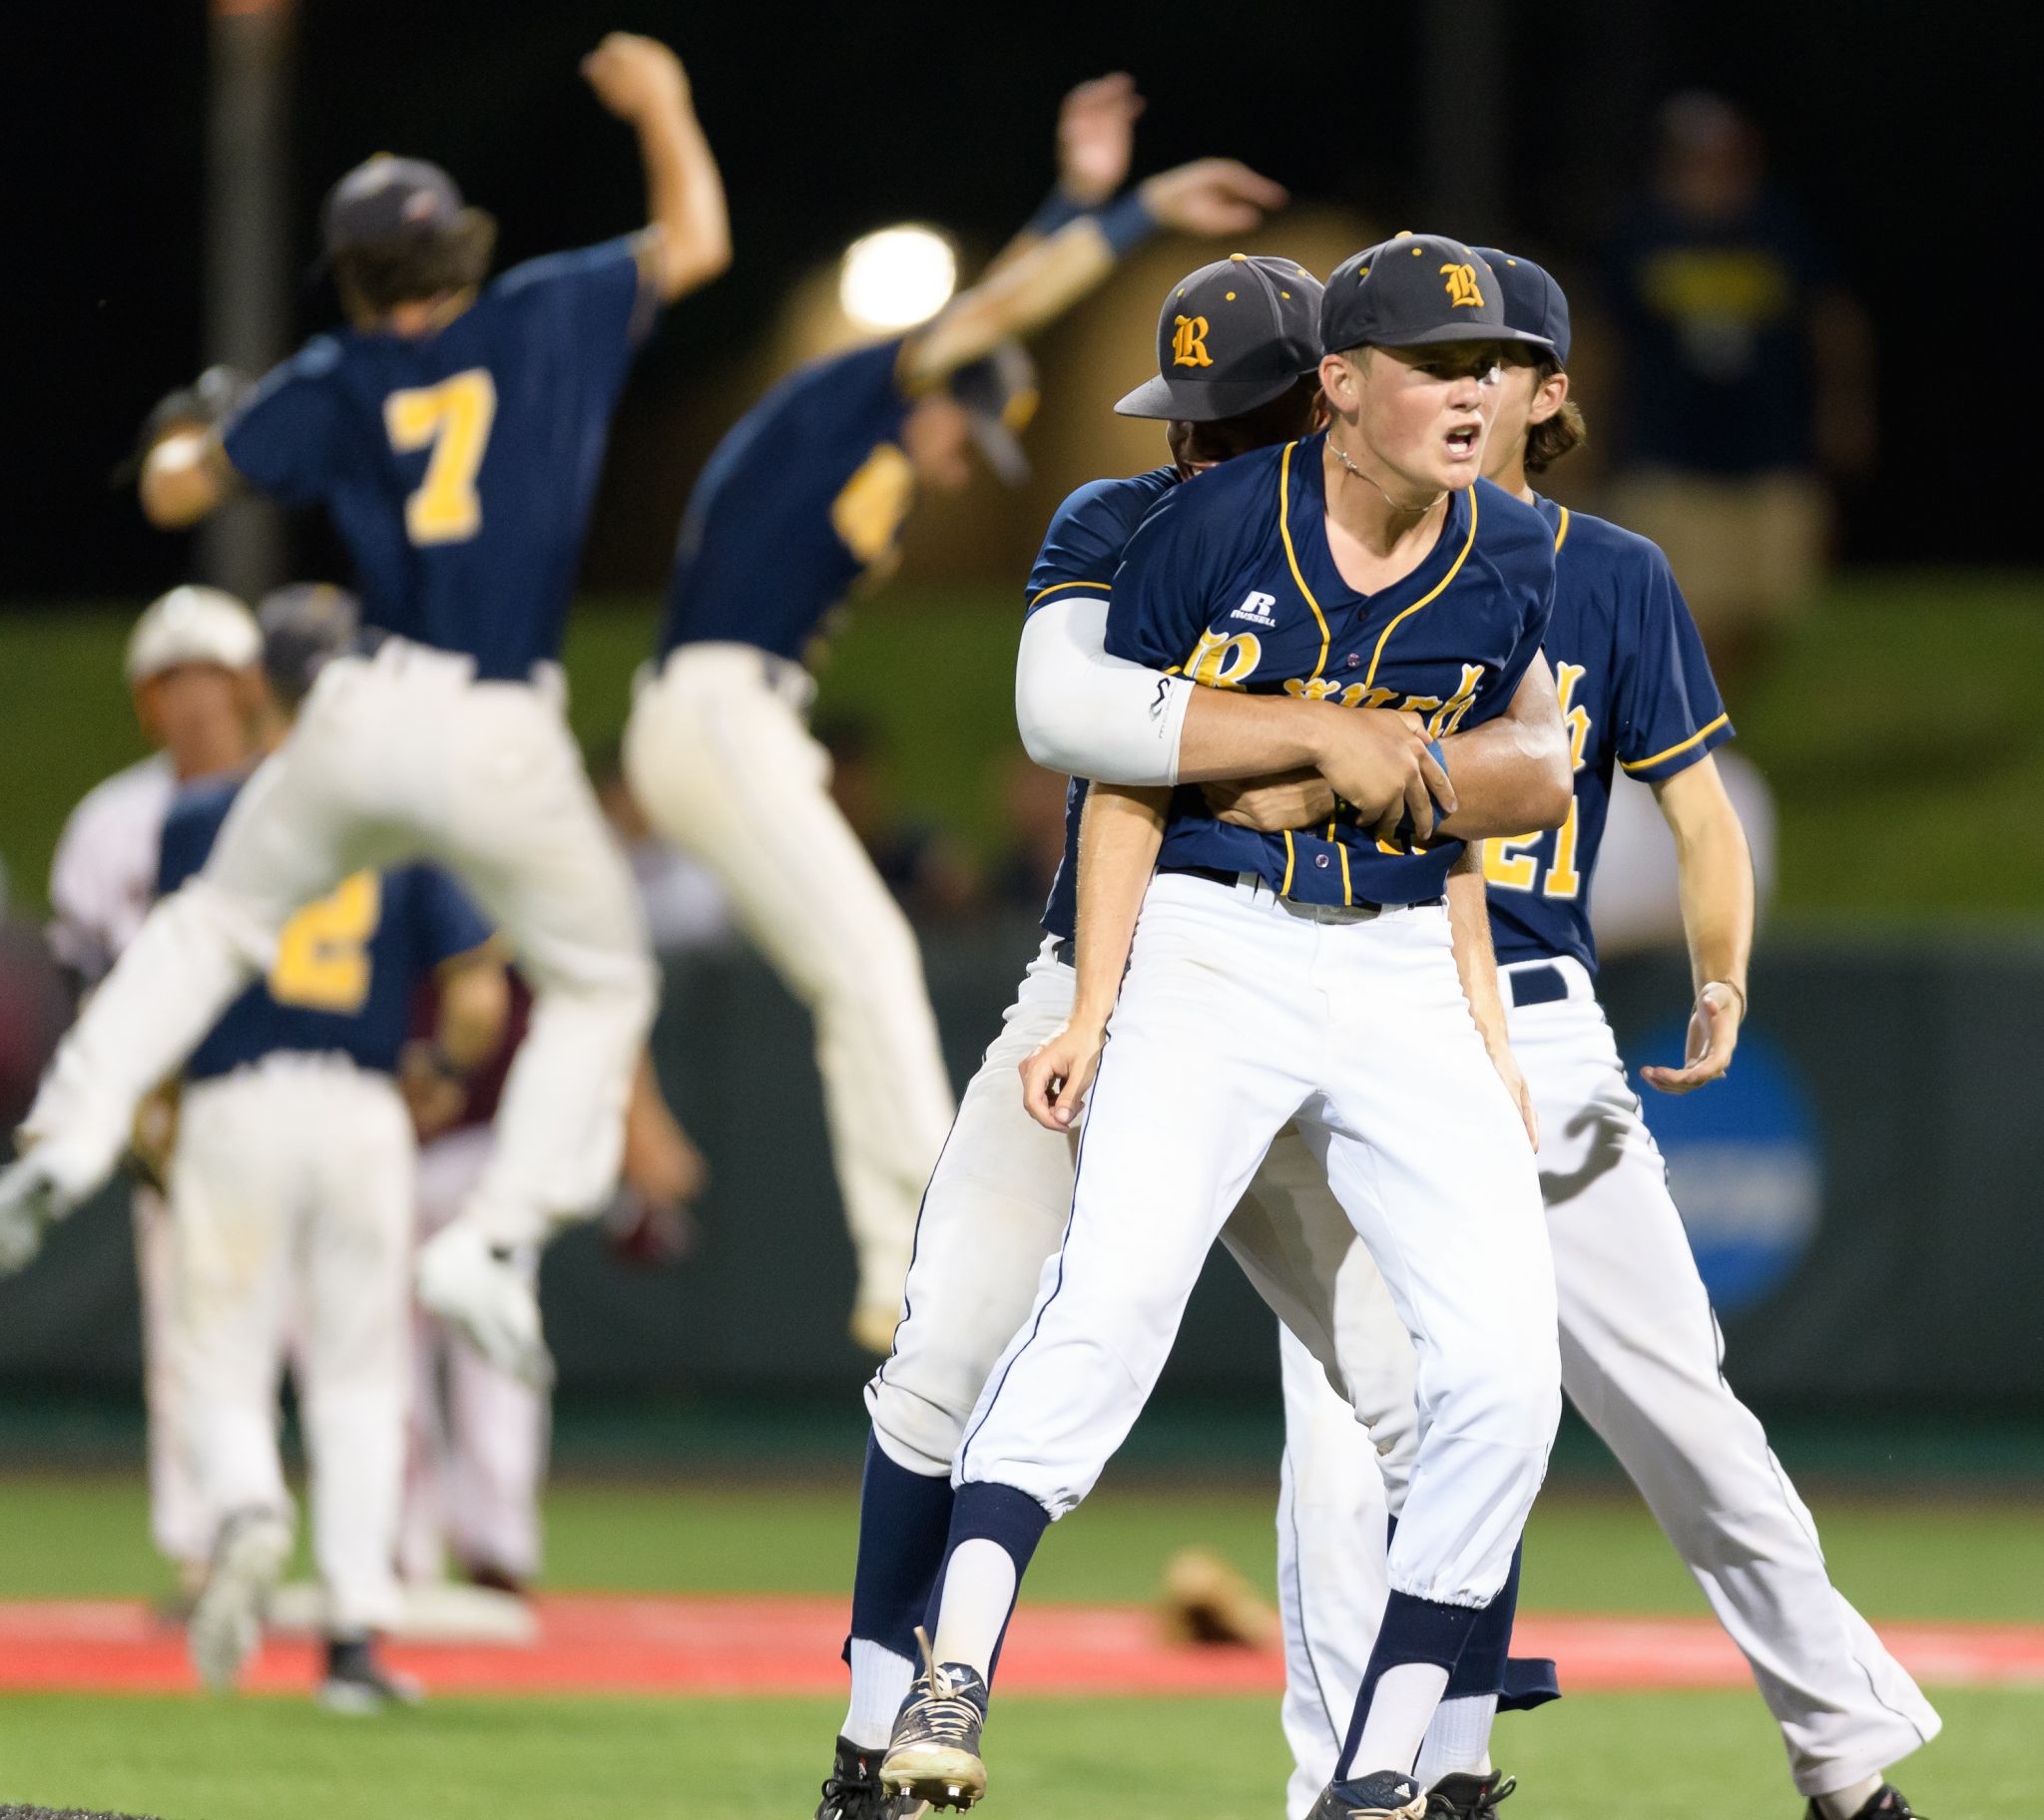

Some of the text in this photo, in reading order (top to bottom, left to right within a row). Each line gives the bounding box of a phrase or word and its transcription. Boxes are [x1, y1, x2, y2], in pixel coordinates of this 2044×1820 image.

[1440, 262, 1485, 307] R
[1172, 314, 1214, 367] R
[383, 366, 497, 546] 7
[1230, 609, 1276, 628] RUSSELL
[1240, 590, 1277, 617] R
[1482, 794, 1580, 898] 21
